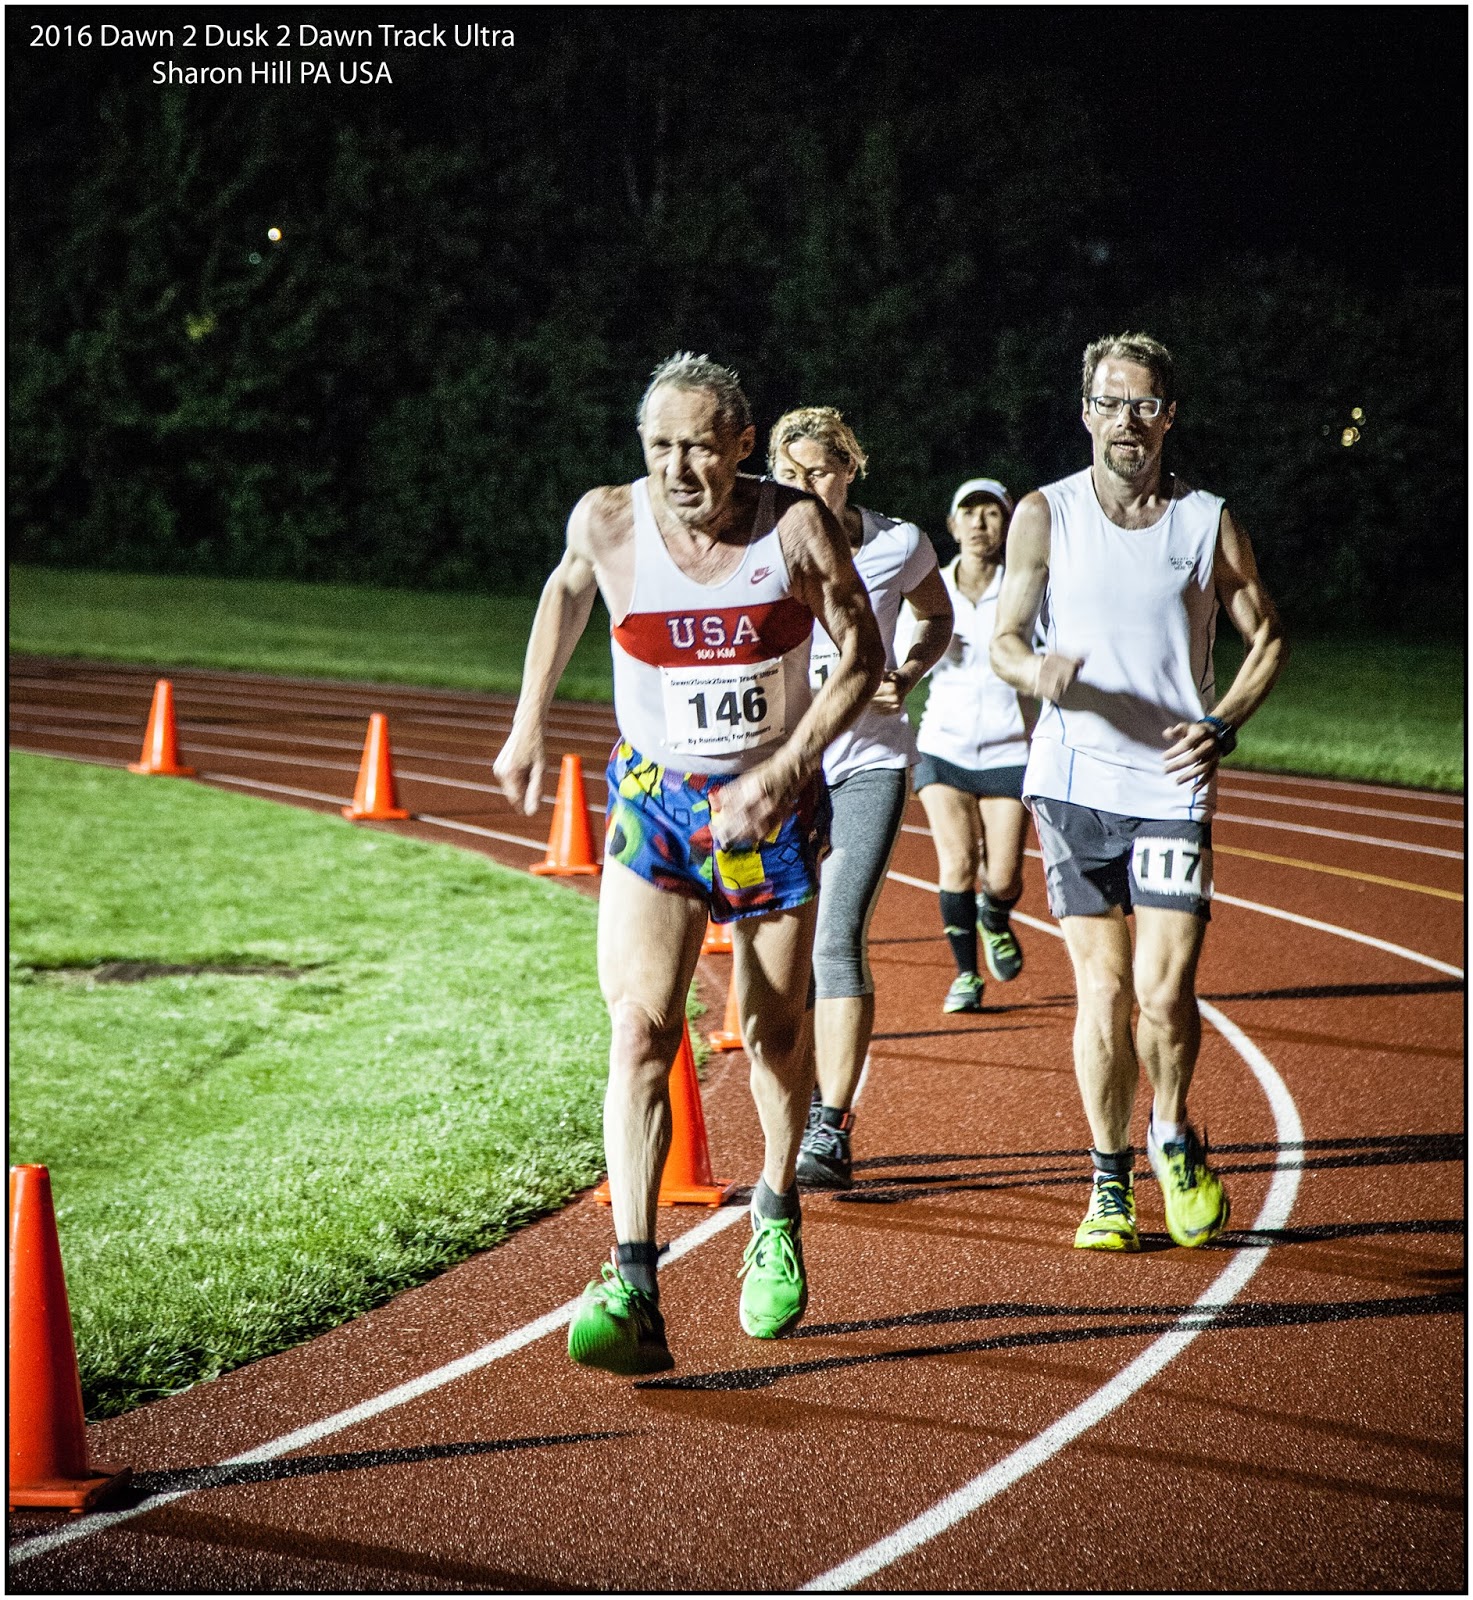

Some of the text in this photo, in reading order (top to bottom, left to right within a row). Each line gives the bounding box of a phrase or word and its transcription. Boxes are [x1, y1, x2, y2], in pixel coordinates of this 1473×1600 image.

[667, 614, 760, 649] USA
[695, 647, 736, 660] 100 KM
[688, 686, 768, 729] 146
[1136, 848, 1201, 882] 117
